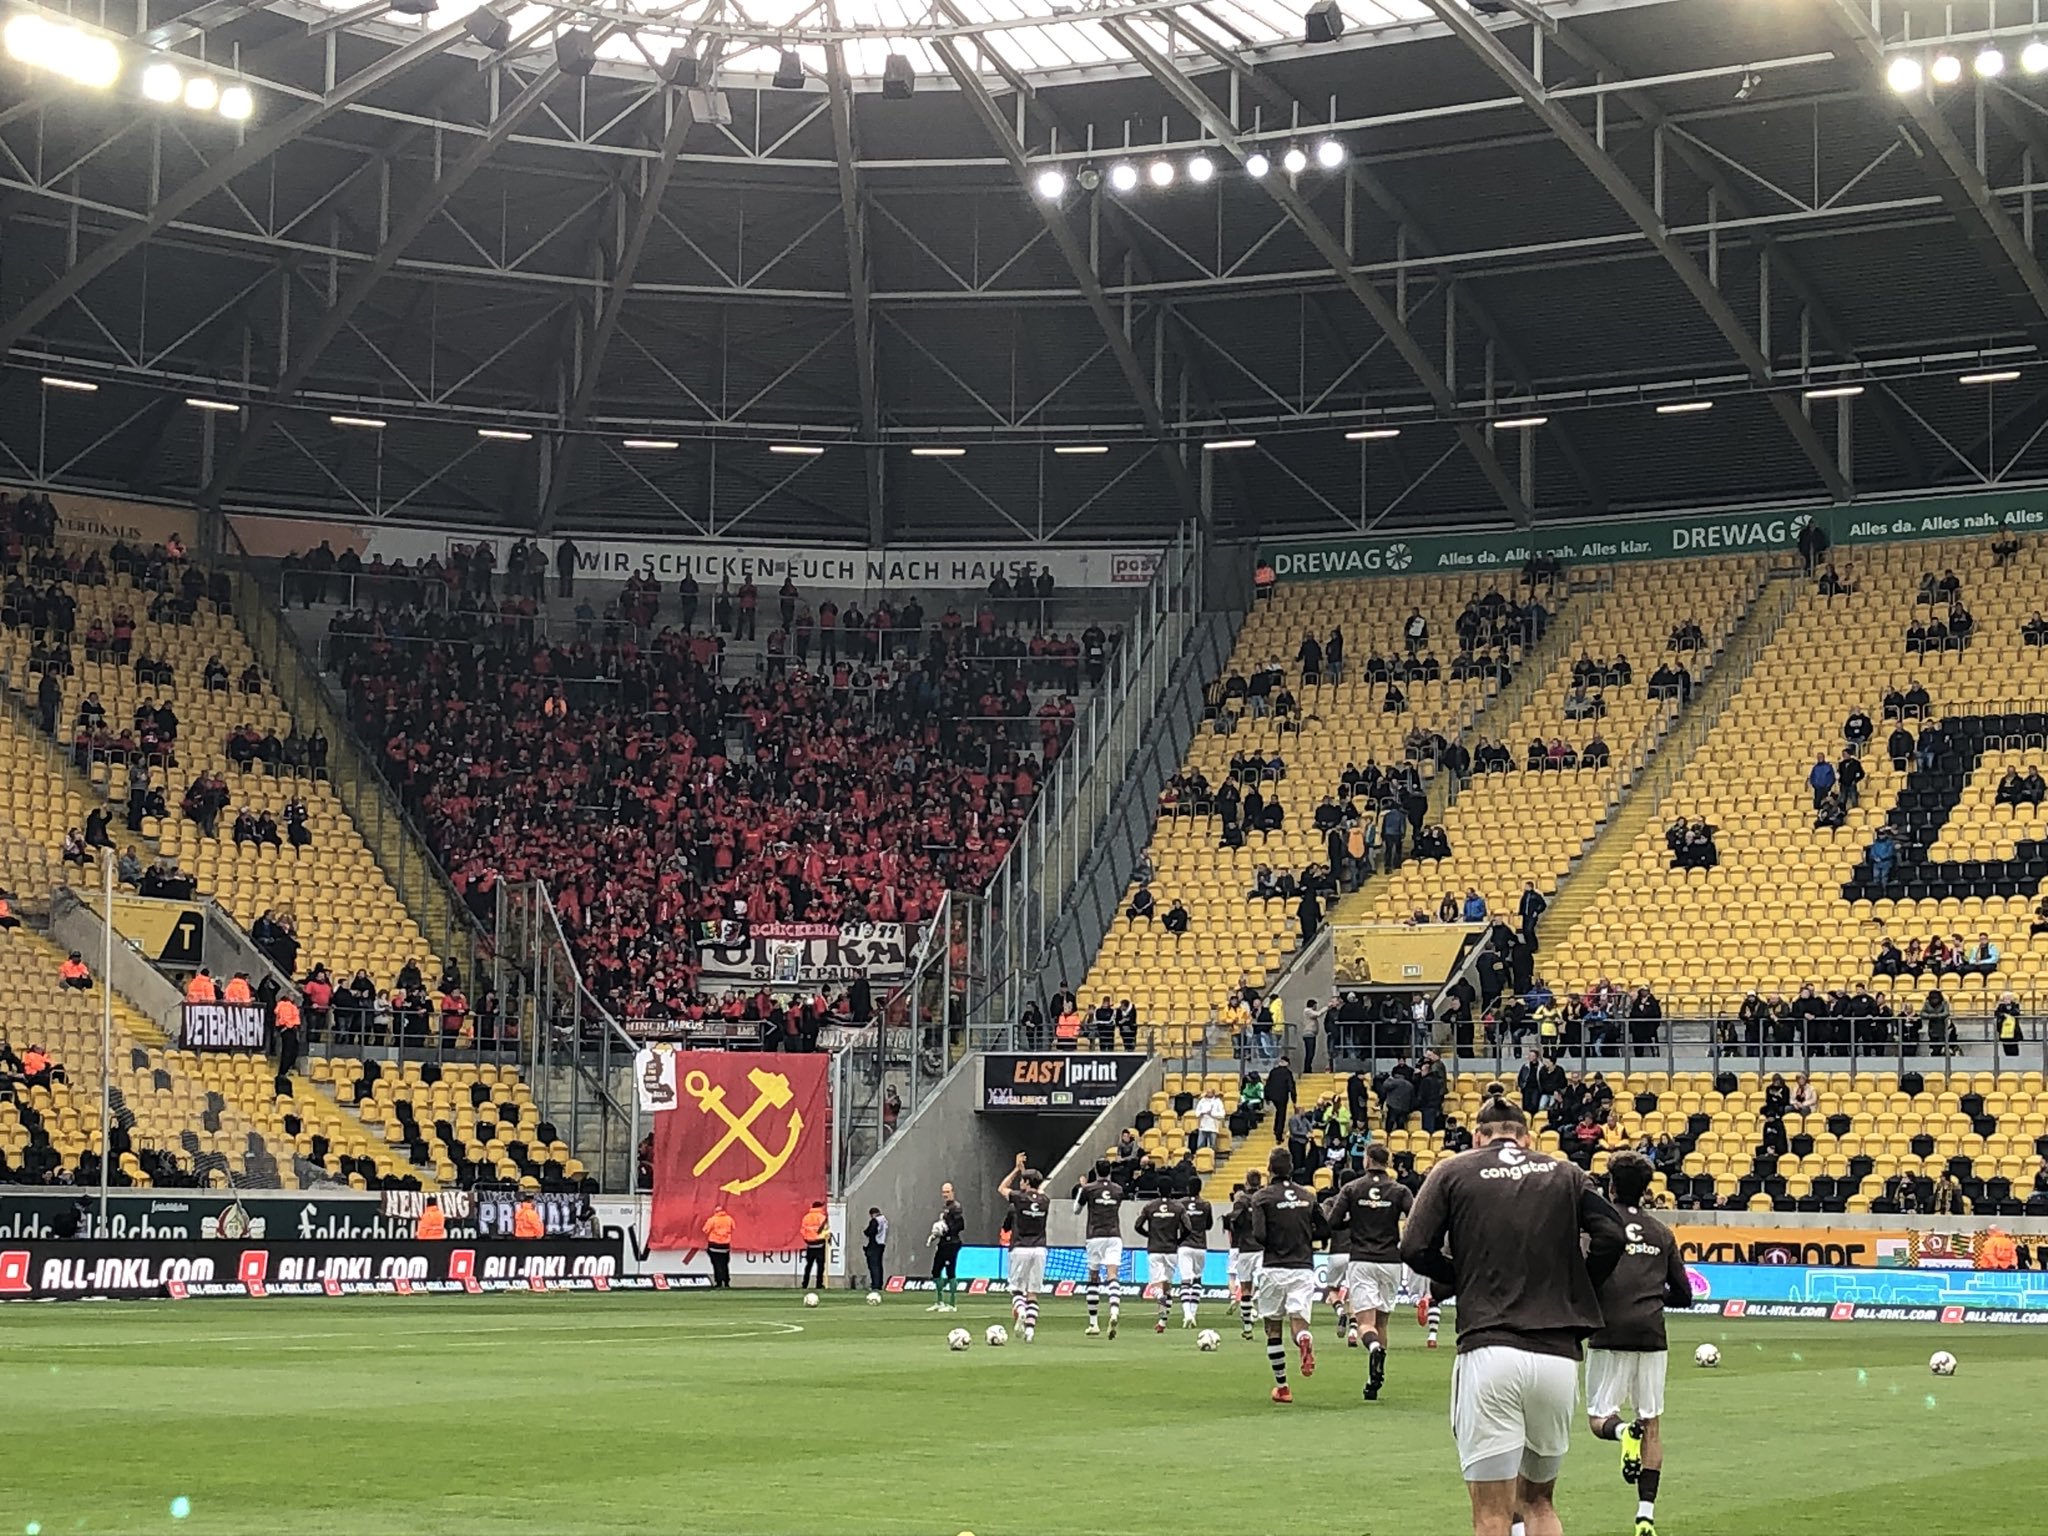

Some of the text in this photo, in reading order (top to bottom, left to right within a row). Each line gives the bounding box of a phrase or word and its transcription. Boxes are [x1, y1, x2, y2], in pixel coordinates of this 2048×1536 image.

[1672, 521, 1786, 550] DREWAG
[1850, 510, 2044, 536] Alles da. Alles nah. Alles
[576, 551, 630, 572] WIR
[642, 553, 775, 577] SCHICKEN
[788, 558, 854, 581] EUCH
[866, 560, 940, 581] NACH
[1275, 548, 1381, 574] DREWAG
[1438, 552, 1473, 567] Alles
[1478, 550, 1500, 564] da.
[1582, 544, 1617, 558] Alles
[1621, 540, 1652, 555] klar.
[179, 923, 195, 950] T
[186, 1006, 264, 1047] VETERANEN
[1013, 1060, 1118, 1084] EAST print
[1479, 1160, 1558, 1181] congstar
[1625, 1242, 1661, 1257] gstar
[41, 1257, 215, 1290] ALL-INKL.COM
[1747, 1304, 1828, 1318] ALL-INKL.COM
[1854, 1308, 1938, 1321] ALL-INKL.COM
